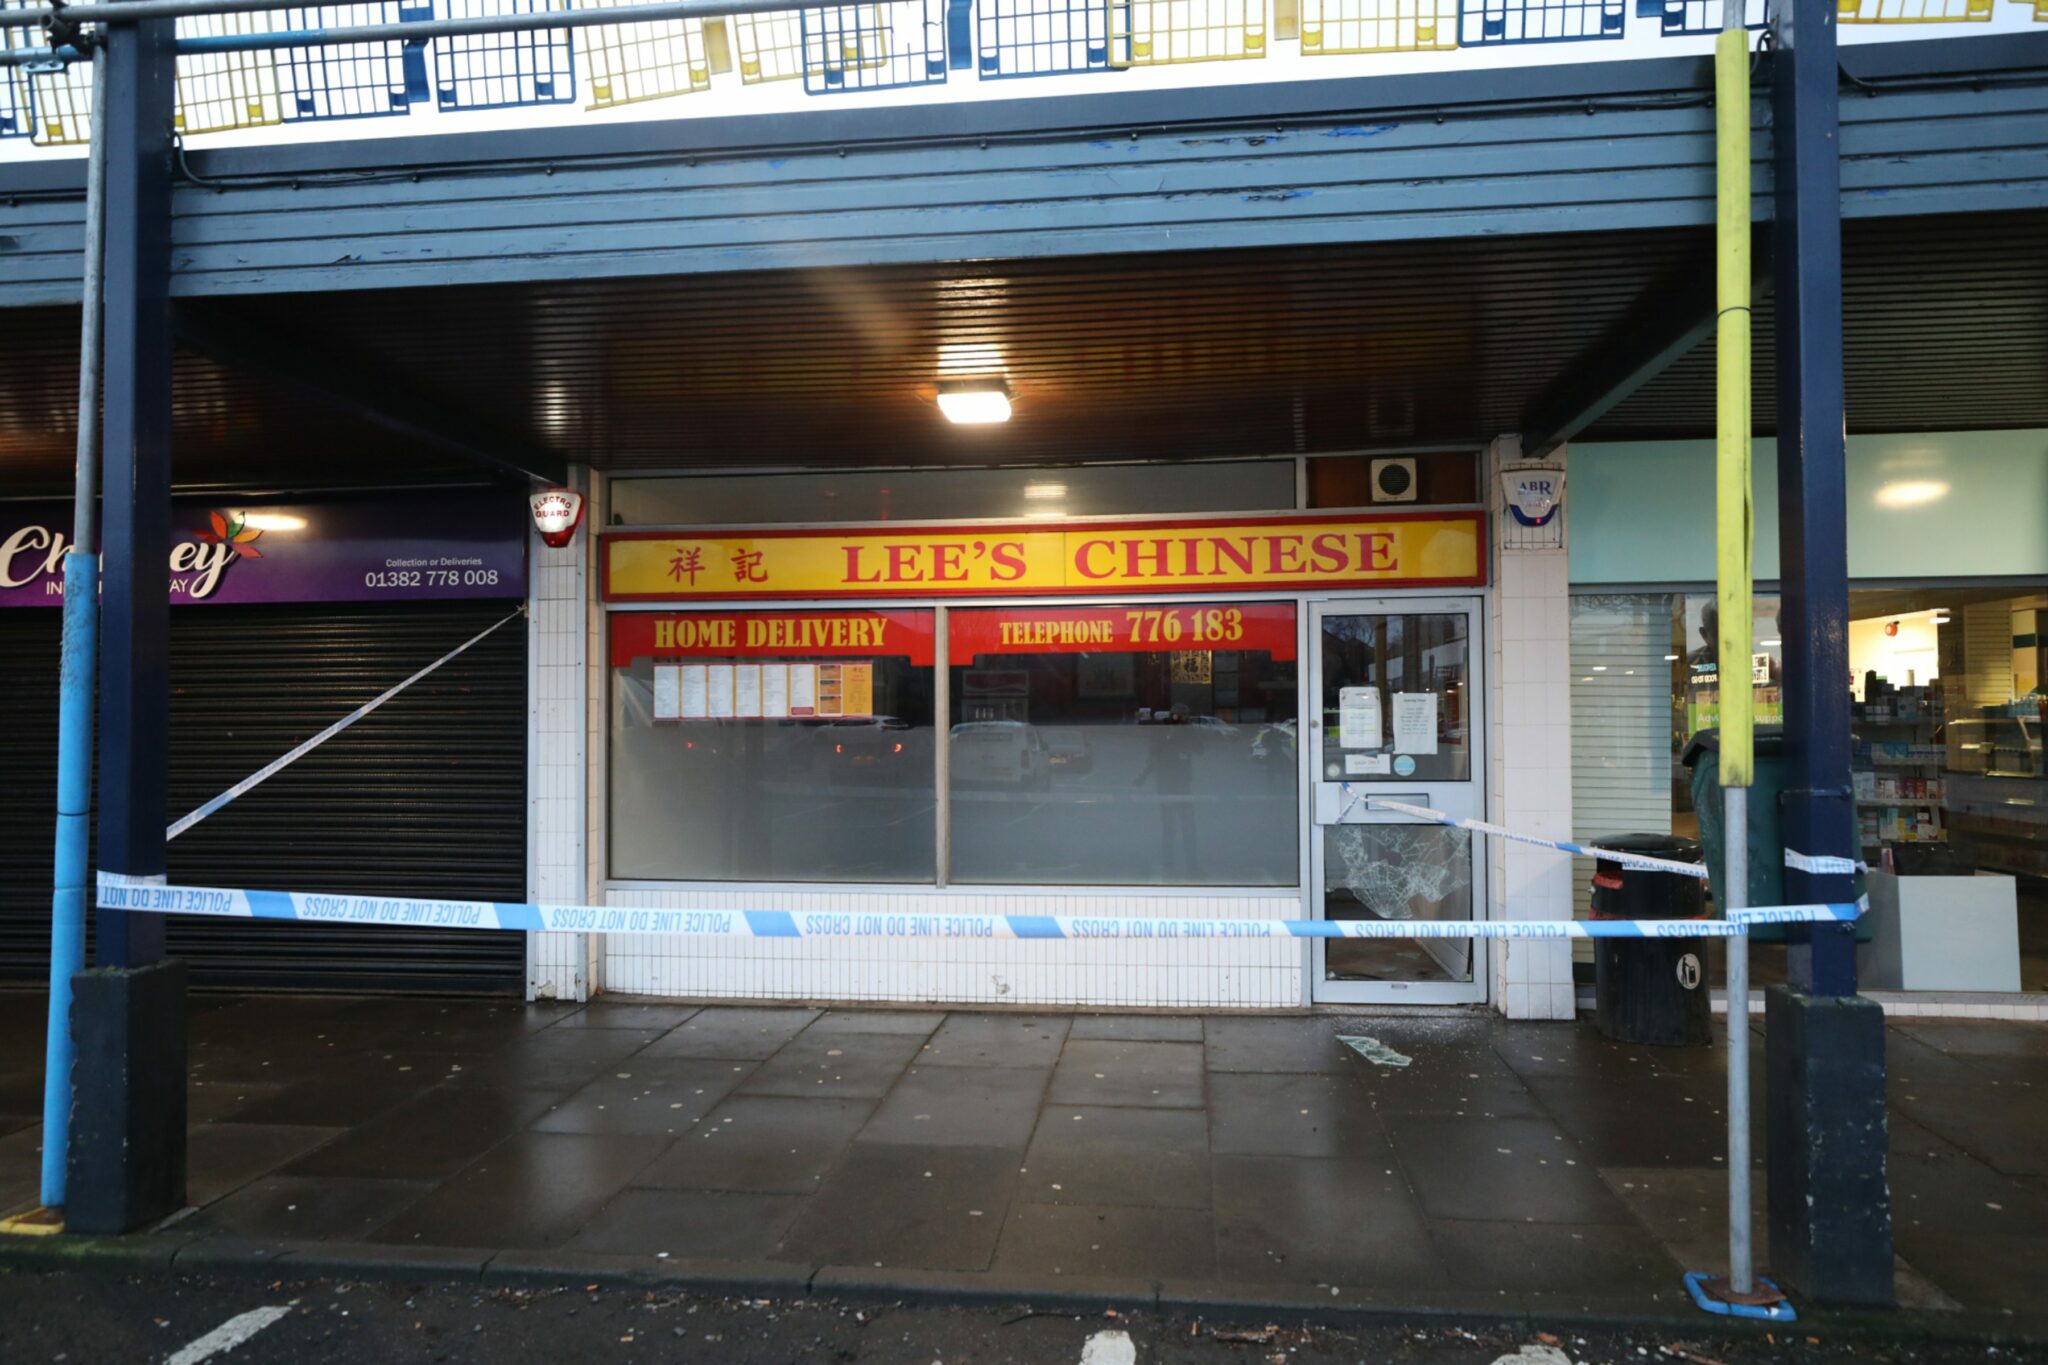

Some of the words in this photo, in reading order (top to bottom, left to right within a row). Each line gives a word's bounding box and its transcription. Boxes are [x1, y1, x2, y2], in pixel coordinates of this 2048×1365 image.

[1520, 480, 1552, 495] ABR
[533, 495, 573, 510] ELECTRO
[535, 509, 570, 518] GUARD
[386, 557, 428, 568] Collection
[440, 557, 483, 566] Deliveries
[840, 539, 1027, 584] LEE'S
[1074, 532, 1399, 580] CHINESE
[365, 571, 421, 588] 01382
[426, 570, 460, 586] 778
[464, 569, 499, 586] 008
[654, 619, 736, 649] HOME
[746, 617, 888, 648] DELIVERY
[1000, 619, 1113, 646] TELEPHONE
[1126, 610, 1181, 643] 776
[1191, 608, 1243, 641] 183
[102, 886, 127, 906] NOT
[132, 888, 149, 907] DO
[153, 889, 182, 908] LINE
[186, 890, 233, 912] POLICE
[303, 896, 347, 918] CROSS
[350, 899, 377, 919] NOT
[380, 900, 399, 920] DO
[402, 902, 432, 922] LINE
[434, 903, 482, 924] POLICE
[551, 907, 596, 929] CROSS
[598, 909, 624, 929] NOT
[629, 910, 648, 930] DO
[651, 911, 680, 931] LINE
[684, 912, 732, 933] POLICE
[806, 914, 851, 935] CROSS
[855, 915, 881, 936] NOT
[886, 916, 906, 936] DO
[910, 916, 940, 937] LINE
[945, 917, 993, 938] POLICE
